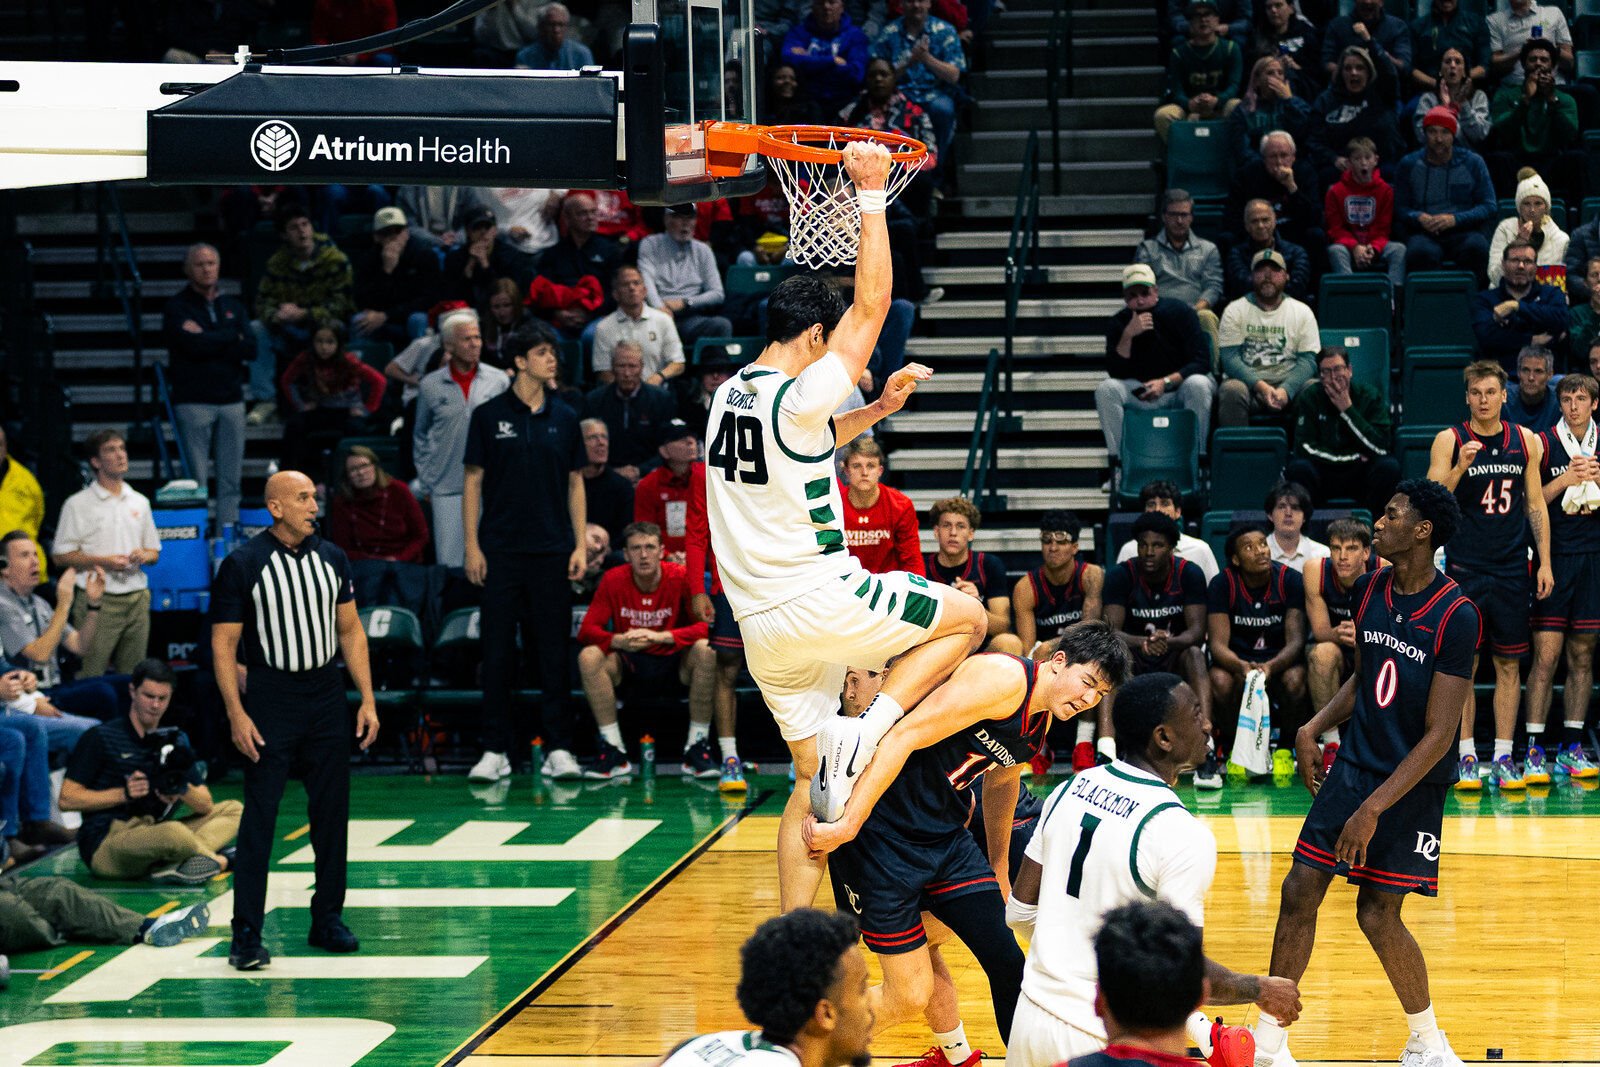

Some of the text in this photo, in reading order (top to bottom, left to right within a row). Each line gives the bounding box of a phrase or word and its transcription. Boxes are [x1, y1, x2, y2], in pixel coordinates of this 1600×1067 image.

[309, 134, 511, 164] Atrium Health
[708, 411, 768, 485] 49
[1468, 464, 1523, 478] DAVIDSON
[1481, 479, 1513, 514] 45
[844, 530, 891, 540] AVIDSON
[369, 609, 392, 637] C
[1131, 606, 1184, 618] DAVIDSON
[1363, 630, 1426, 665] DAVIDSON
[1374, 657, 1399, 709] 0
[974, 728, 1017, 769] DAVIDSO
[1072, 778, 1140, 819] BLACKMON
[1066, 812, 1102, 899] 1
